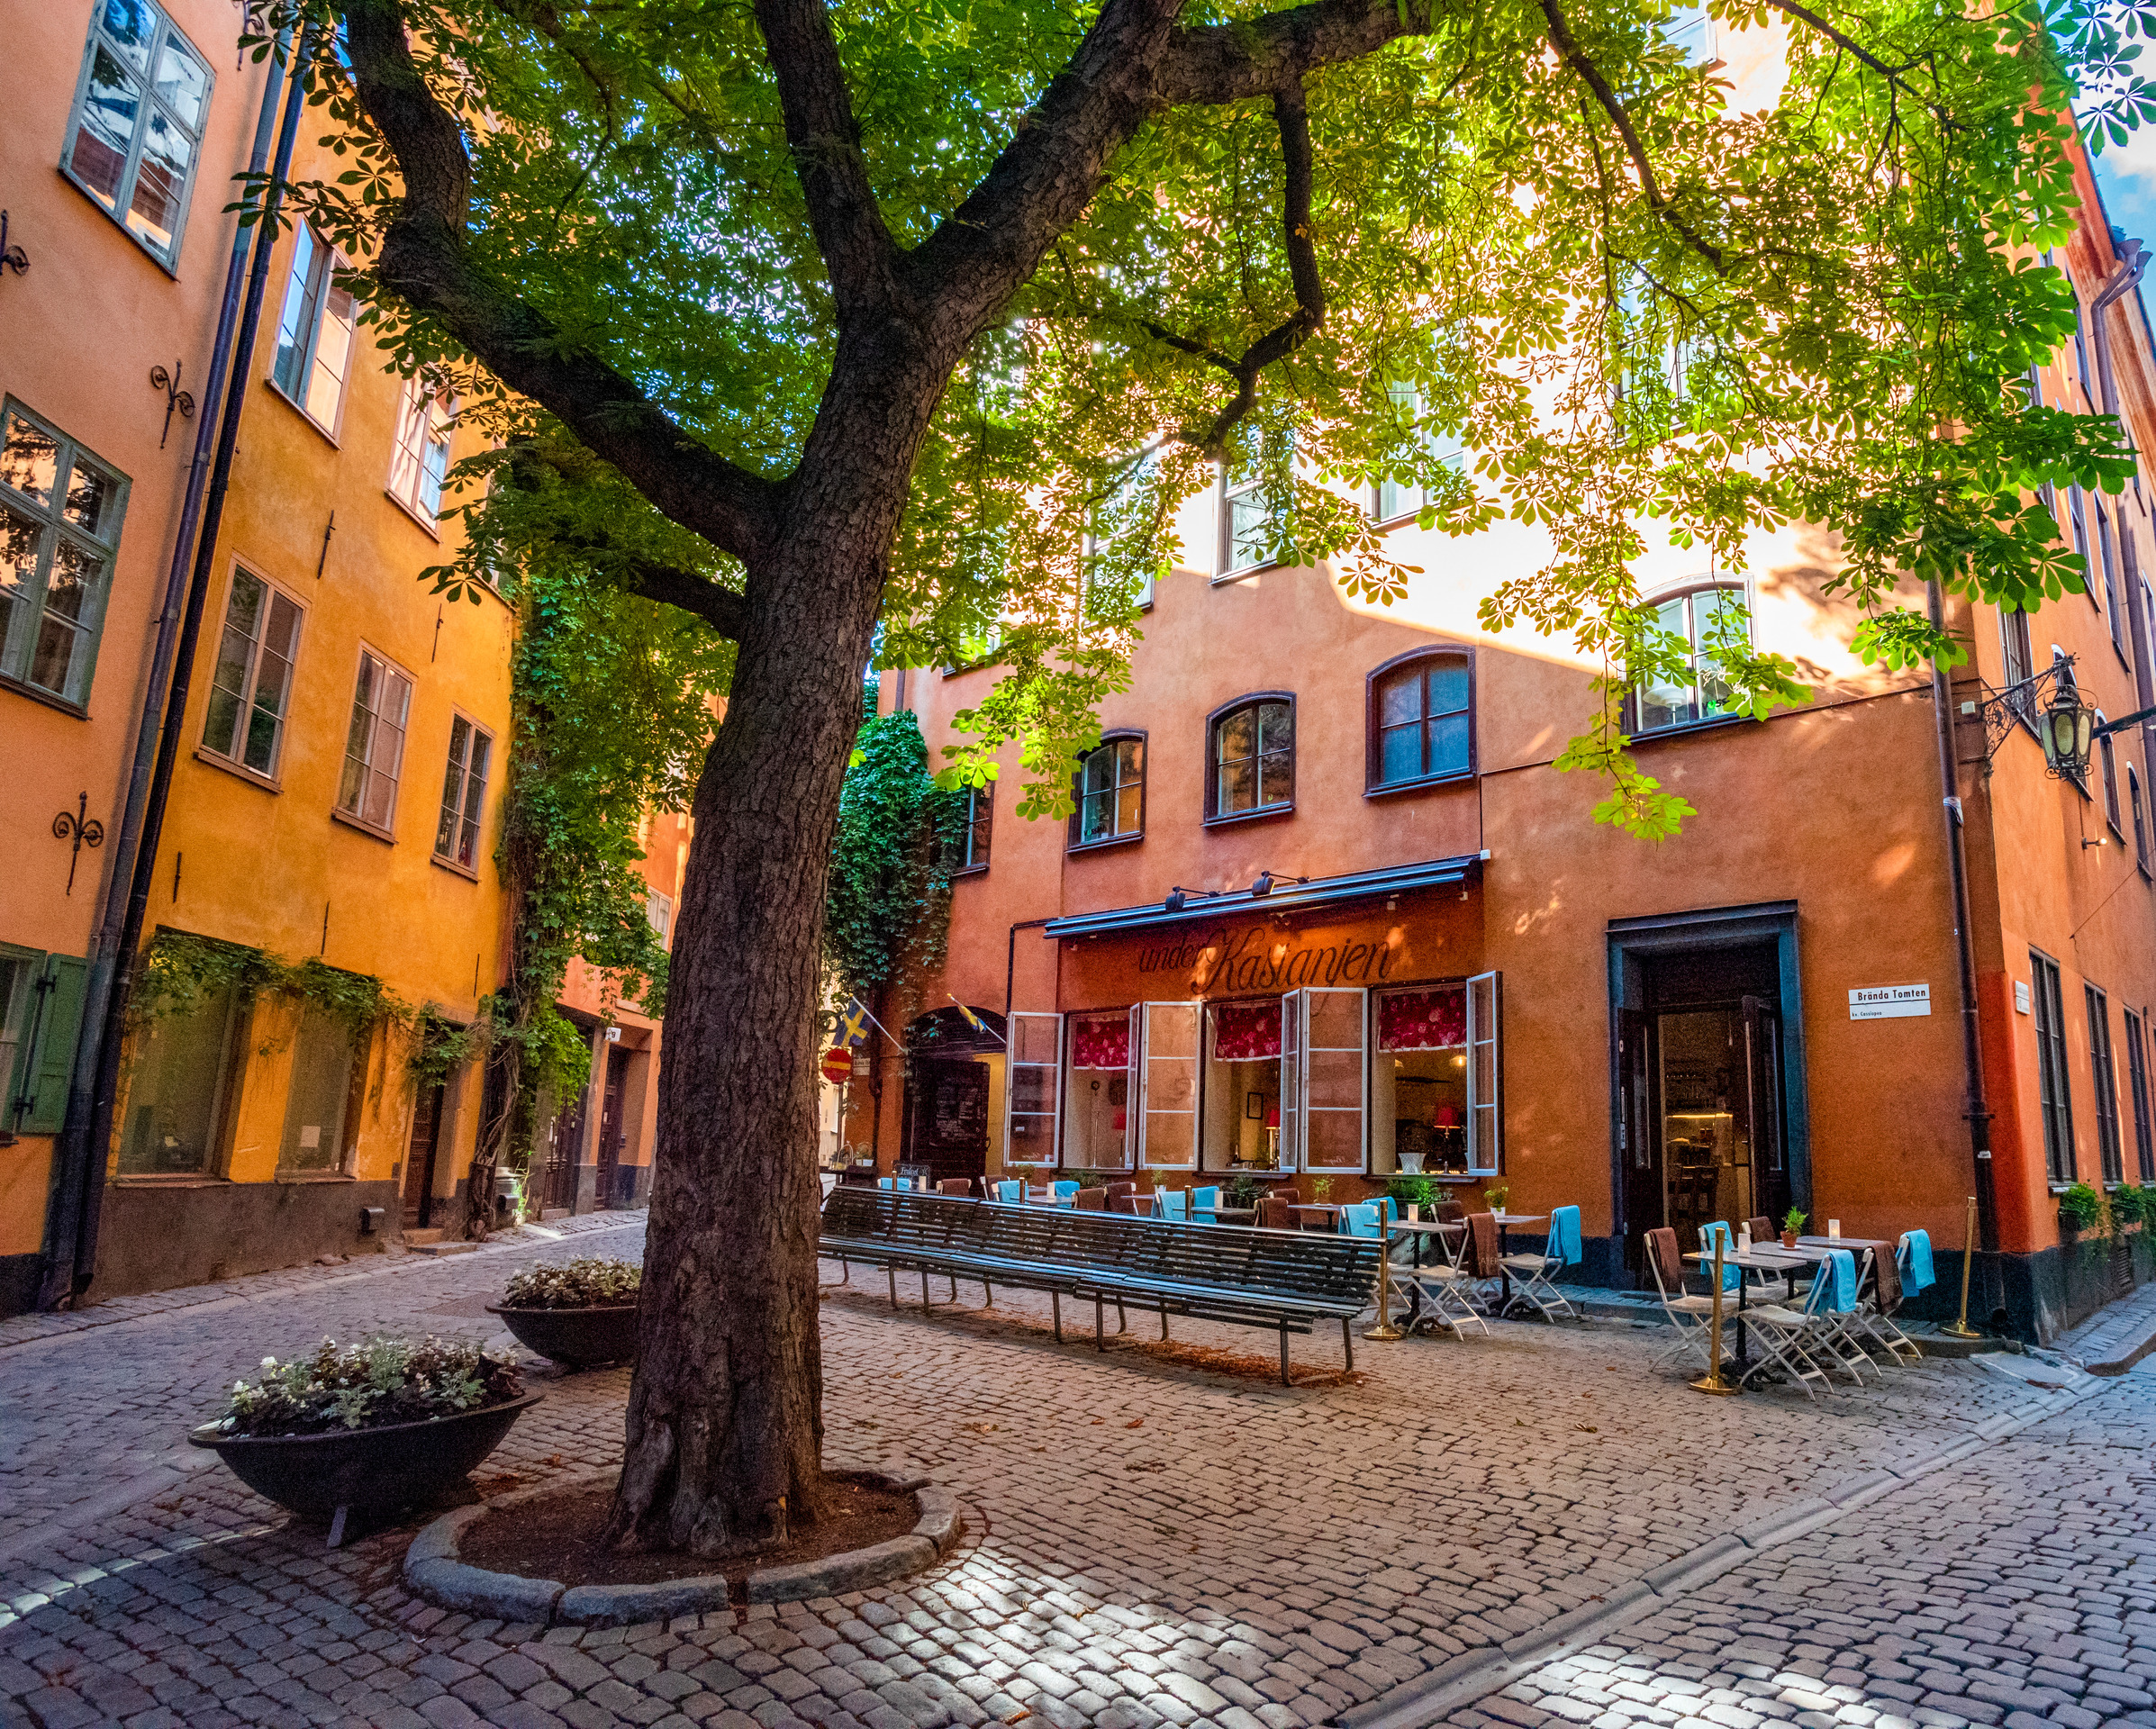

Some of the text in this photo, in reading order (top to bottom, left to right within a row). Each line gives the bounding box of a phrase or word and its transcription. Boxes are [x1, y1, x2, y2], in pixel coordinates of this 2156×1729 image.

[1138, 927, 1392, 994] under Kastanjen
[1857, 989, 1926, 1001] Brända Tomten
